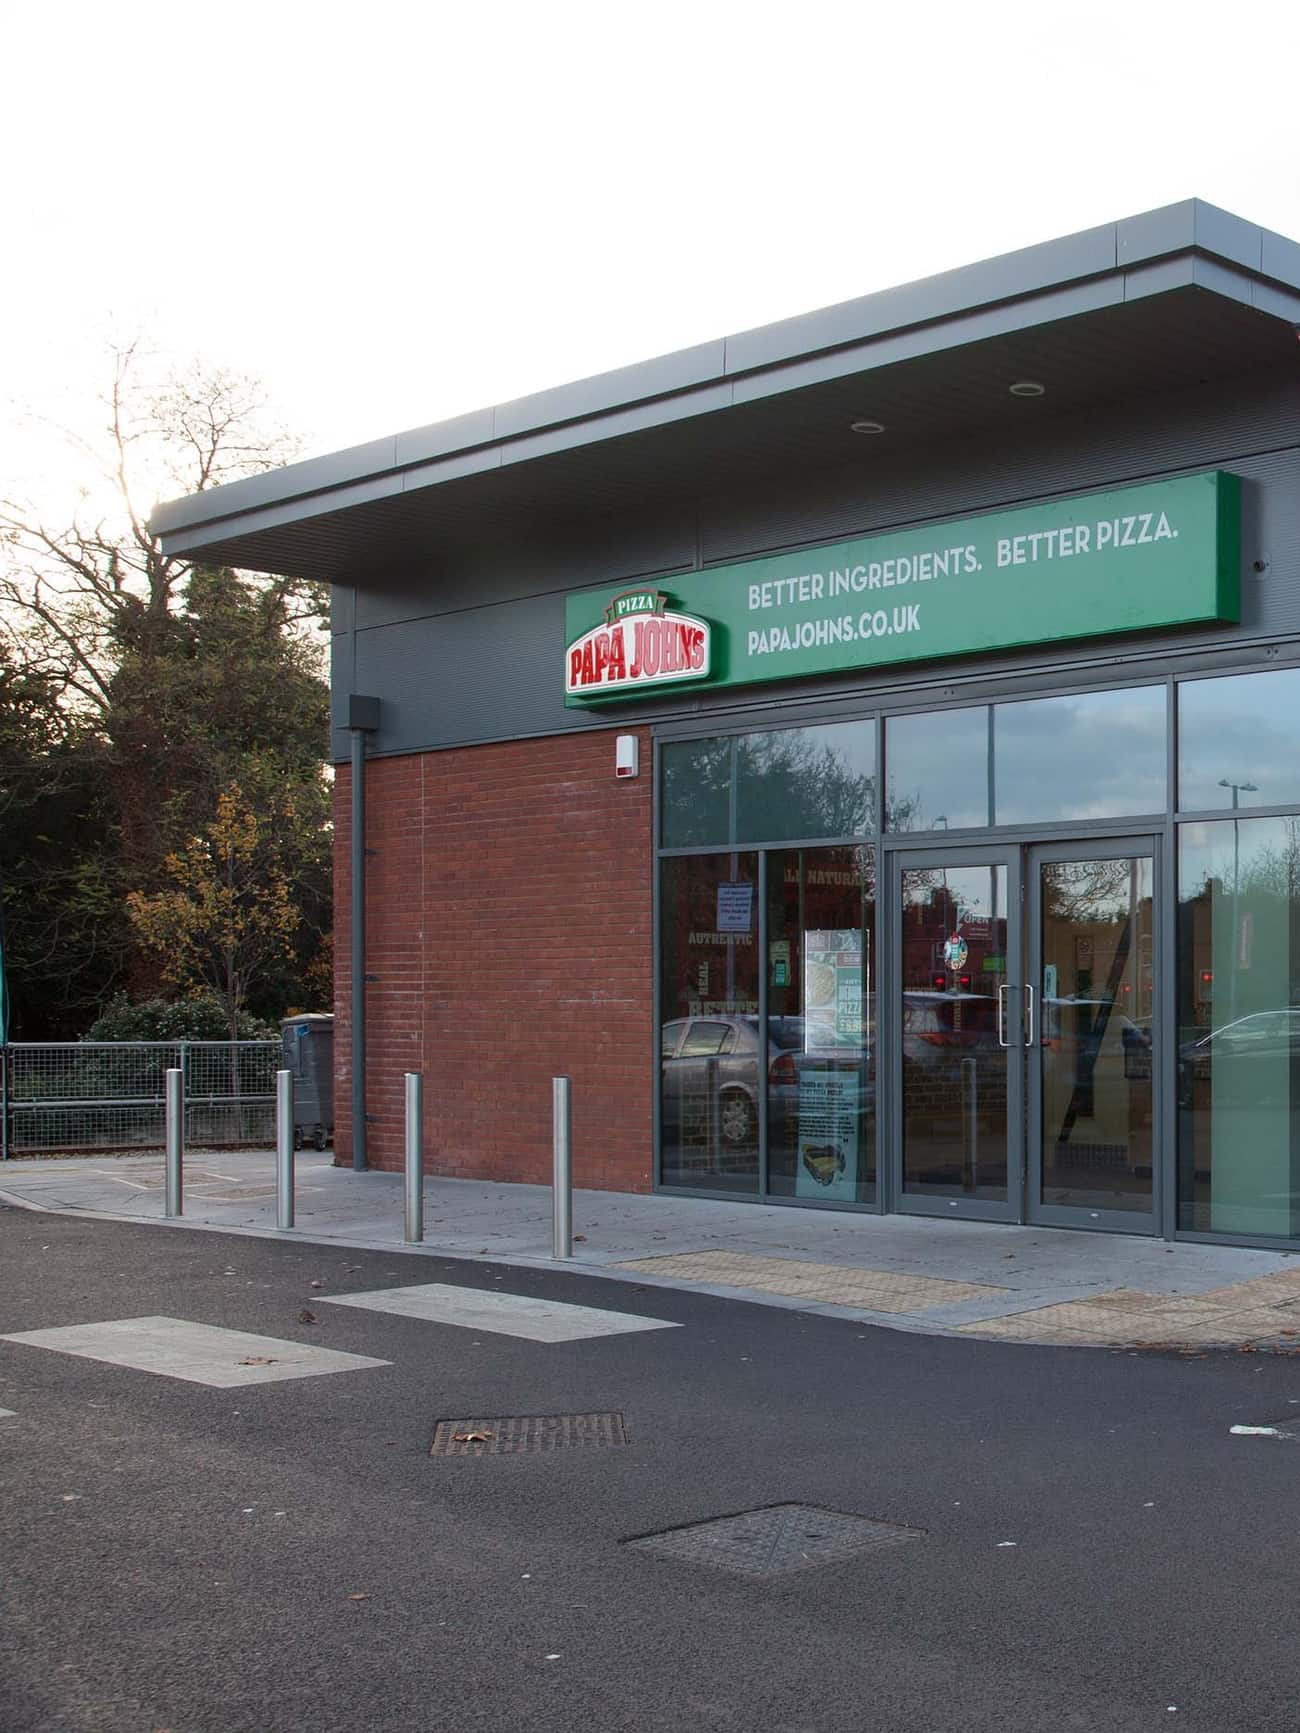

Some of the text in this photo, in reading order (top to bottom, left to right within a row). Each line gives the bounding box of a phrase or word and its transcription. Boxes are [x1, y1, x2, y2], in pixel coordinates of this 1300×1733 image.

[748, 511, 1180, 611] BETTER INGREDIENTS. BETTER PIZZA.
[618, 595, 655, 615] PIZZA
[747, 604, 921, 657] PAPAJOHNS.CO.UK
[570, 626, 626, 687] PAPA
[688, 931, 754, 945] AUTHENTIC
